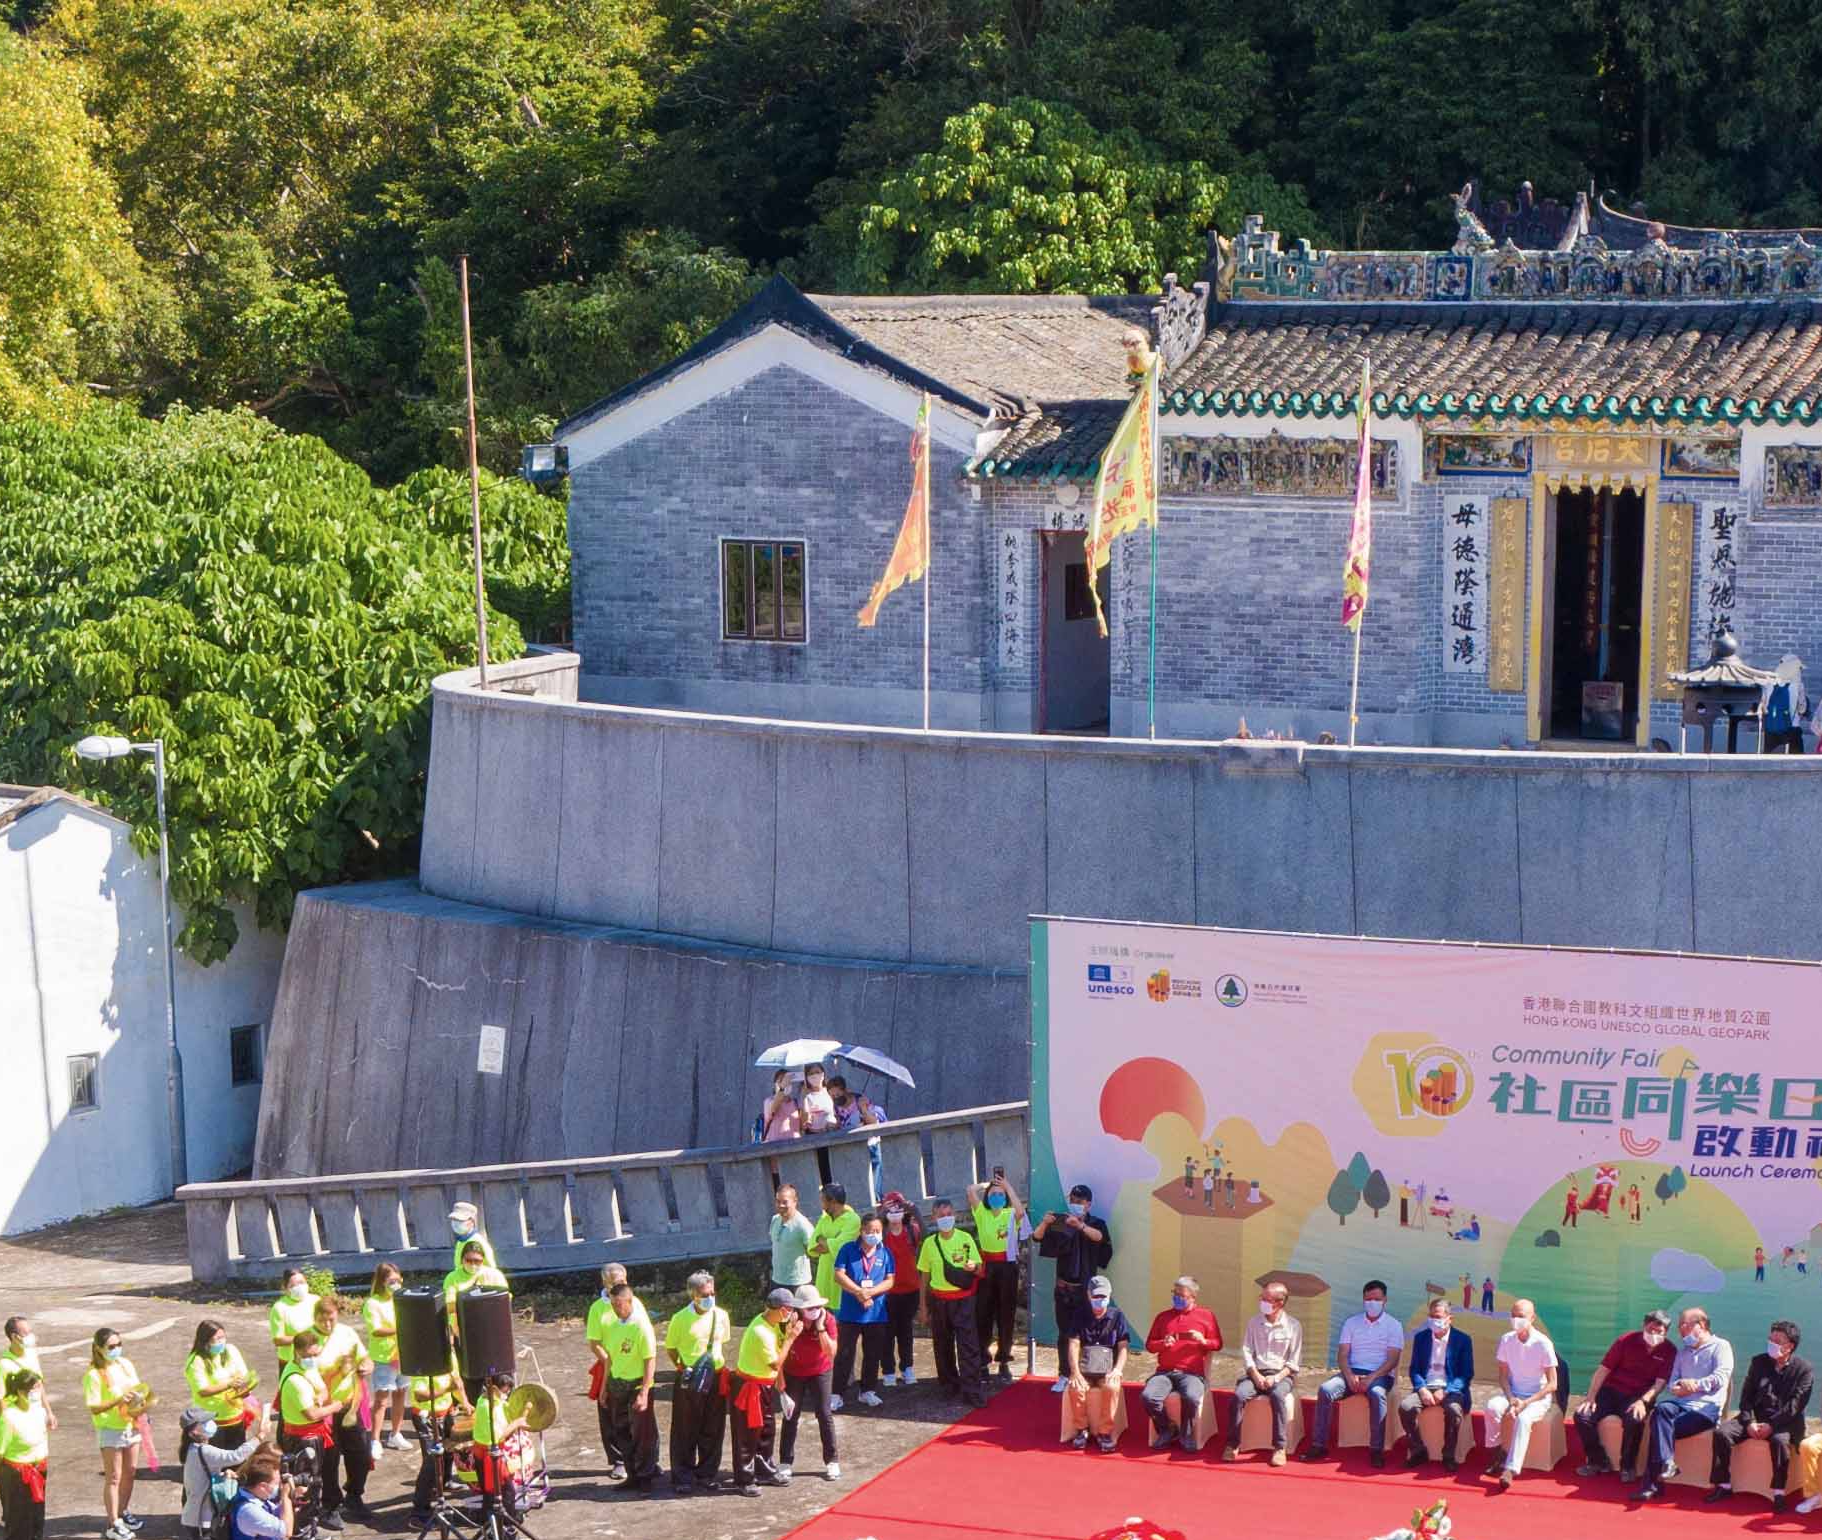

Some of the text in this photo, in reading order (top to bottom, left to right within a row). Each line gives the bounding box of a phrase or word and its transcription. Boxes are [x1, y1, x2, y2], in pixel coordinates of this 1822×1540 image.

[1087, 983, 1135, 996] unesco
[1523, 995, 1772, 1027] 香港聯合國教科文組織世界地質公園
[1523, 1014, 1771, 1041] HONG KONG UNESCO GLOBAL GEOPARK
[1492, 1044, 1616, 1070] Community
[1619, 1047, 1663, 1070] Fair
[1690, 1163, 1753, 1179] Launch
